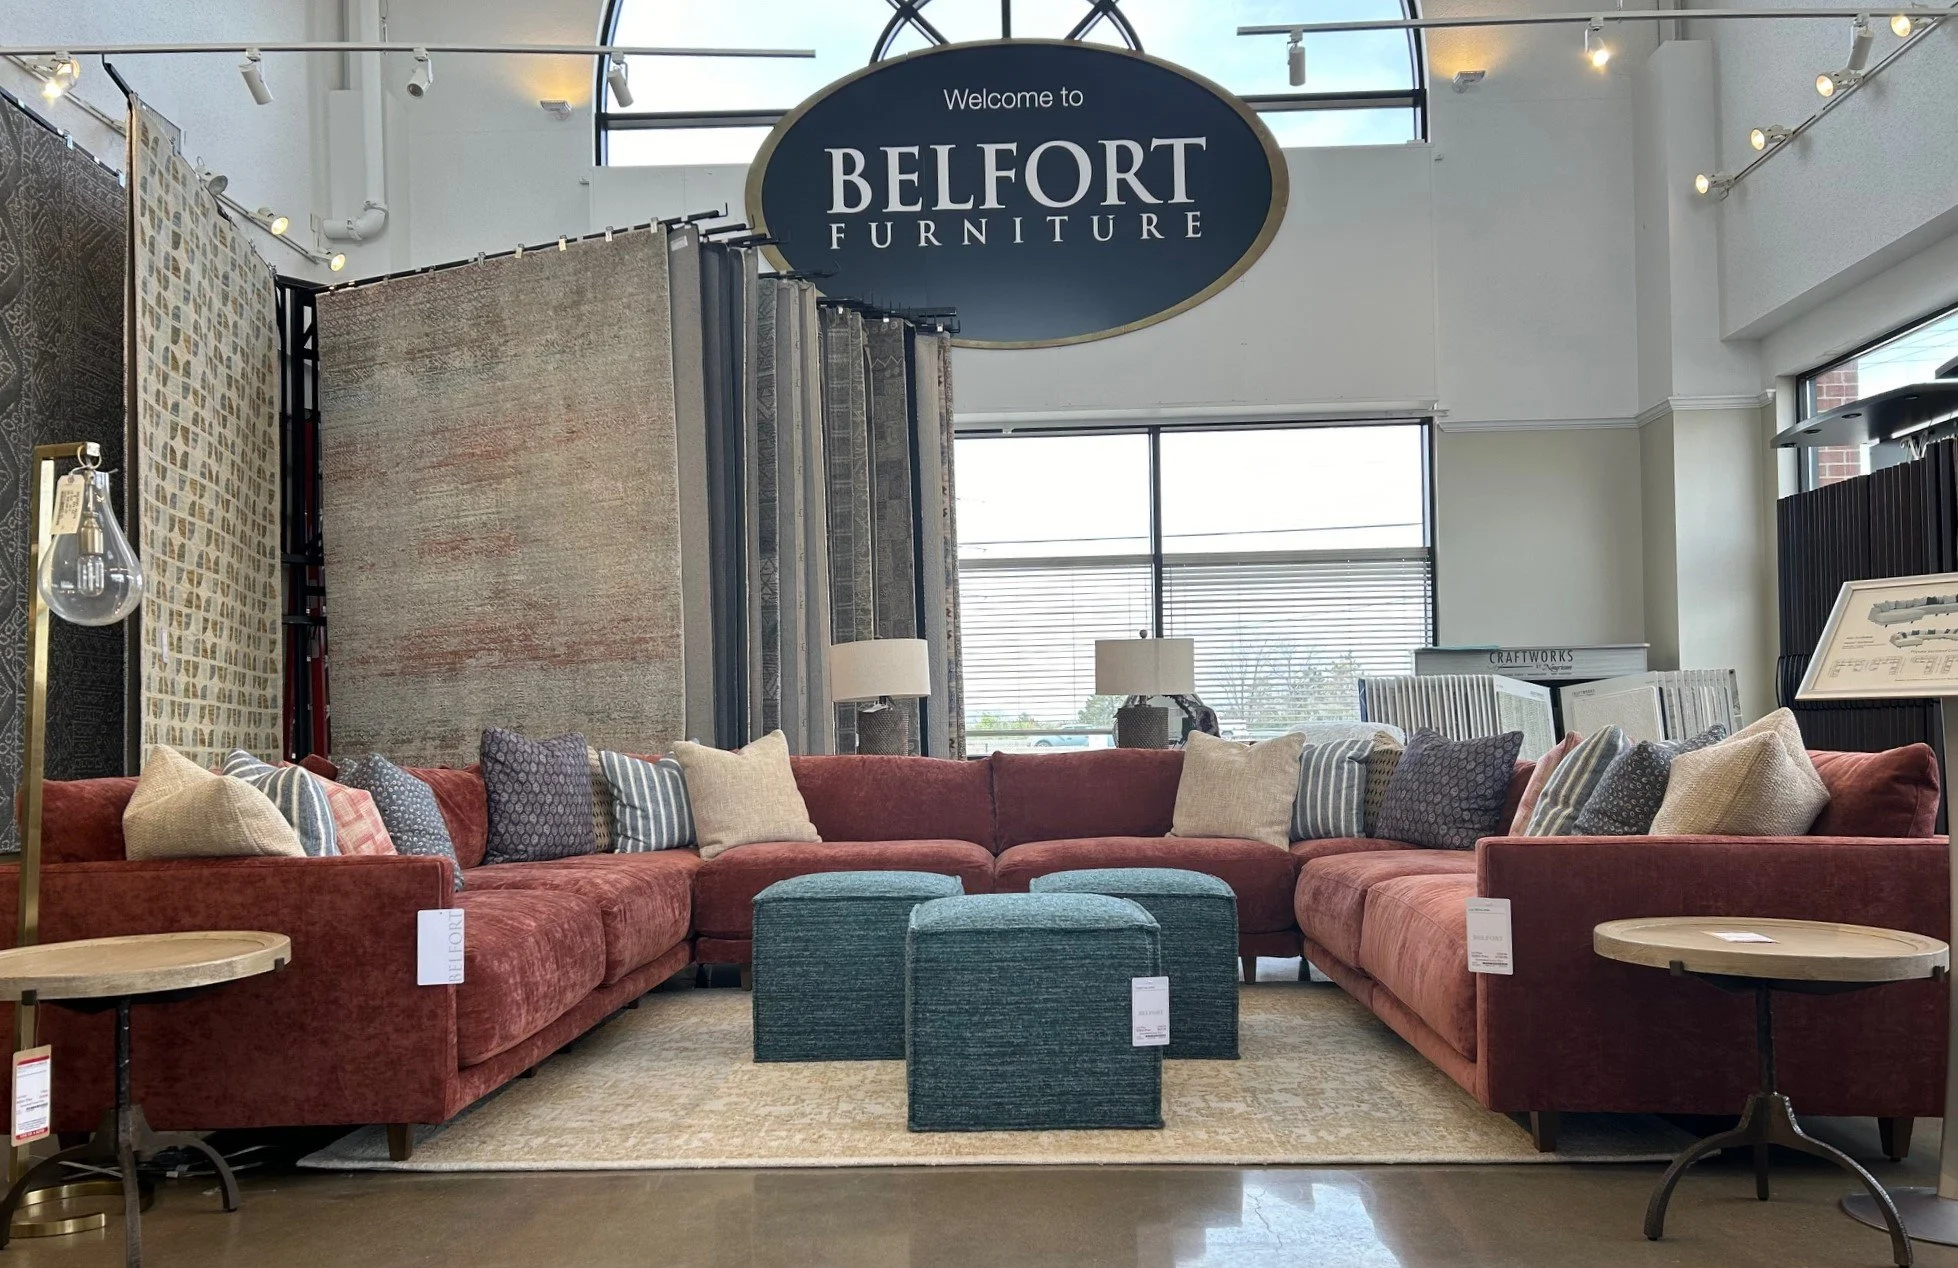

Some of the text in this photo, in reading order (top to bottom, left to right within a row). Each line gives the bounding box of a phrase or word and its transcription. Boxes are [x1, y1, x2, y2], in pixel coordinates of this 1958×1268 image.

[944, 87, 1084, 110] Welcome to
[824, 136, 1207, 213] BELFORT
[830, 211, 1202, 250] FURNITURE
[1489, 650, 1574, 664] CRAFTWORKS
[448, 910, 463, 982] BELFORT
